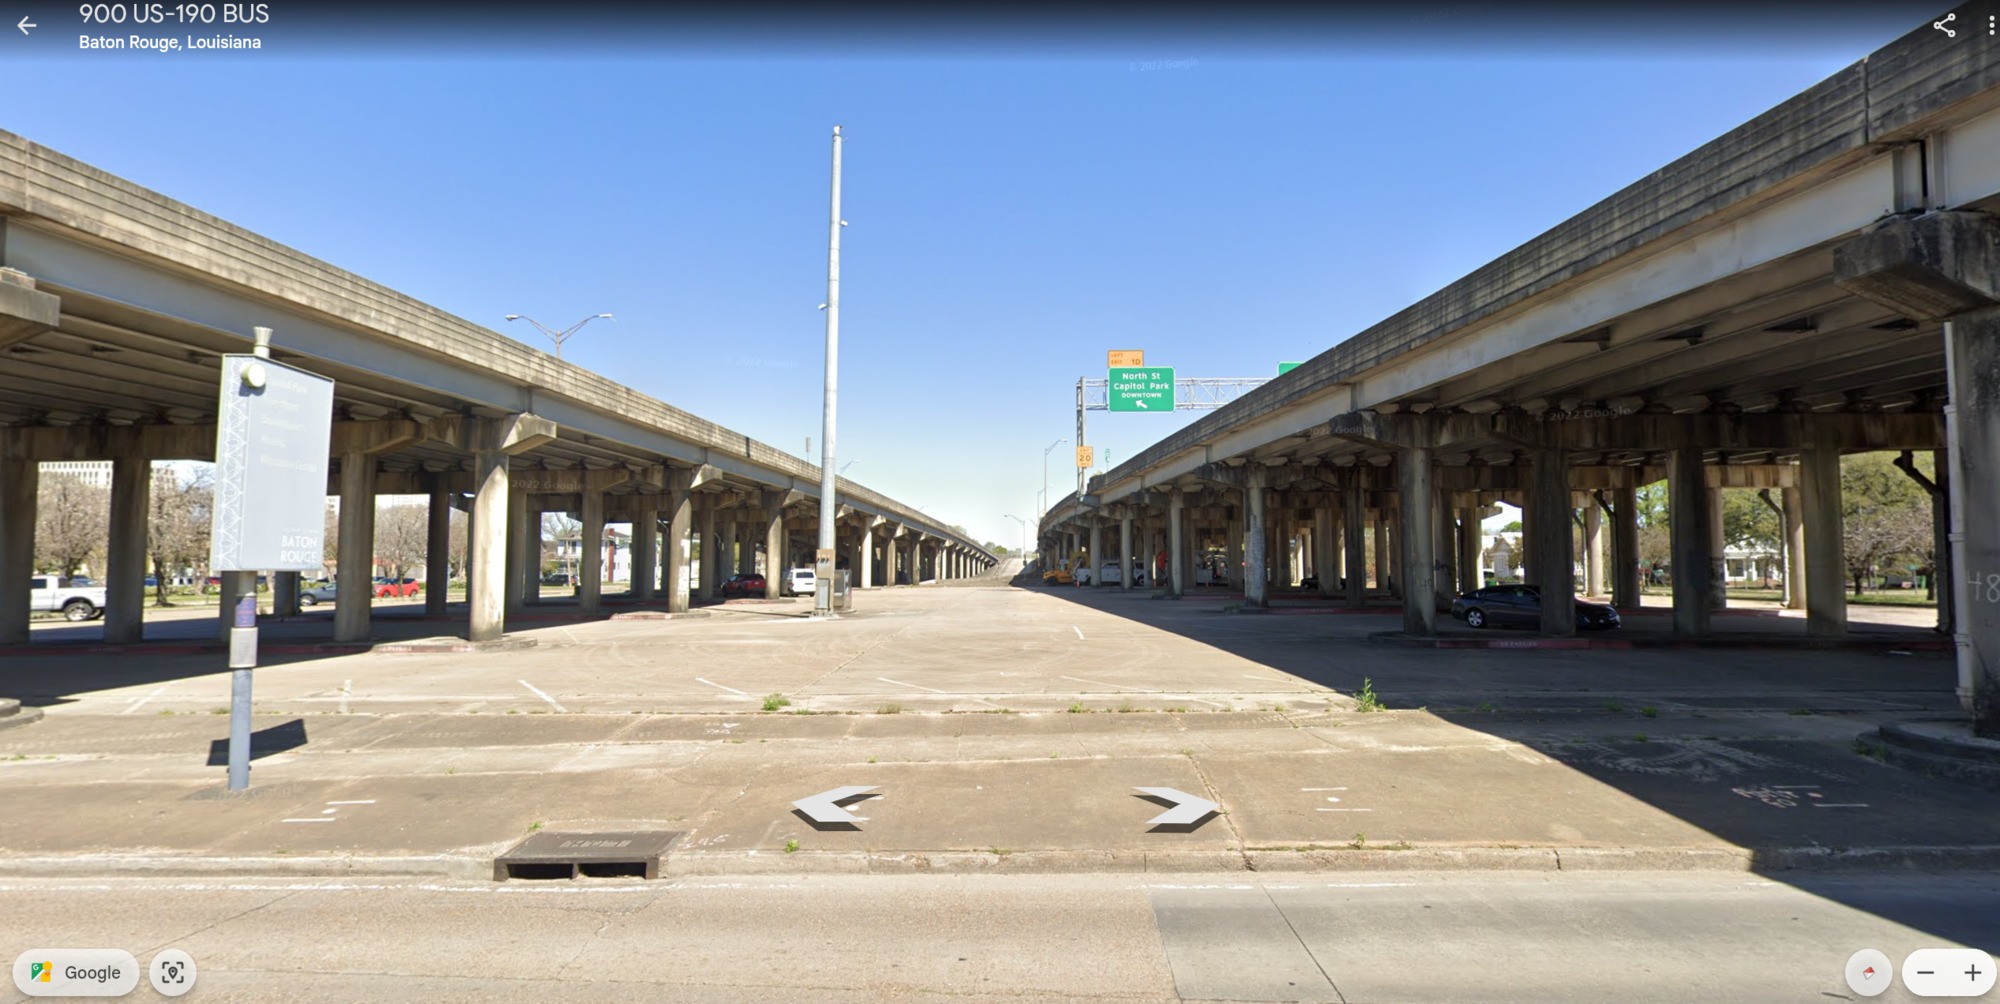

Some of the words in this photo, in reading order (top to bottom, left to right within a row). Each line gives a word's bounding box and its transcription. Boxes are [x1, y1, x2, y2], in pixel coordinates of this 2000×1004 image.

[1122, 372, 1147, 380] North
[1151, 372, 1161, 380] St
[1113, 381, 1145, 392] Capitol
[1150, 381, 1170, 390] Park
[1079, 454, 1091, 462] 20
[281, 535, 317, 549] BATON
[280, 549, 318, 563] ROUGE
